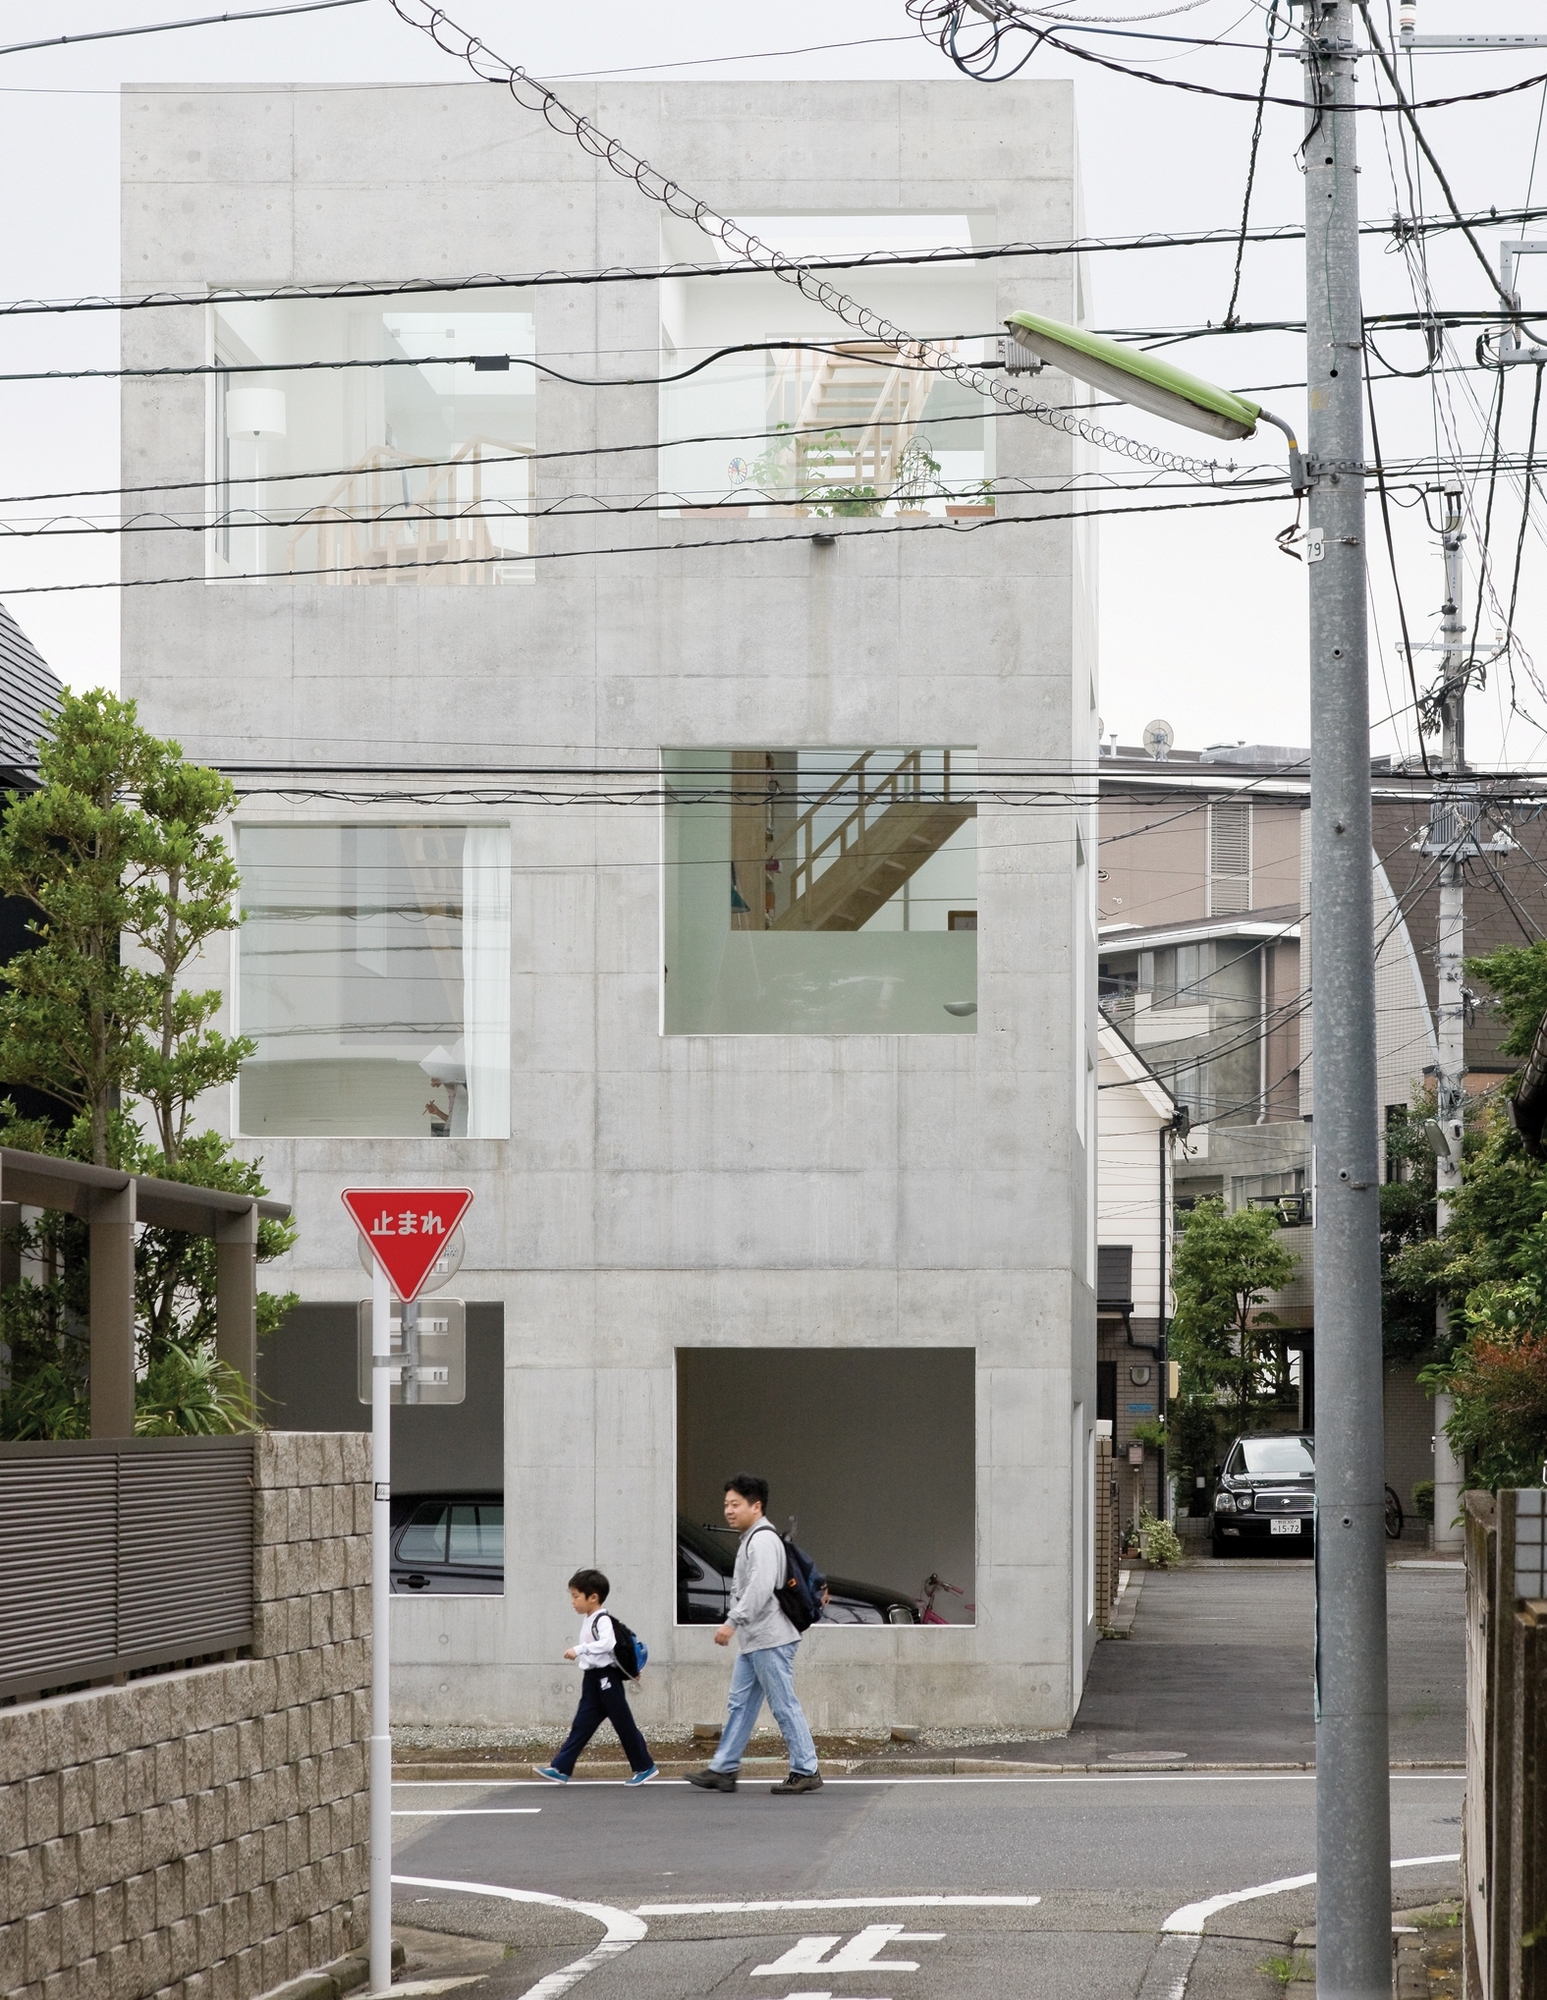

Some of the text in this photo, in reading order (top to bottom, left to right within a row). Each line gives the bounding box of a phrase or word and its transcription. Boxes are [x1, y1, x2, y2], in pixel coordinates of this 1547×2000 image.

[1307, 542, 1321, 558] 79
[370, 1210, 445, 1235] 止まれ
[750, 1924, 947, 2000] 止
